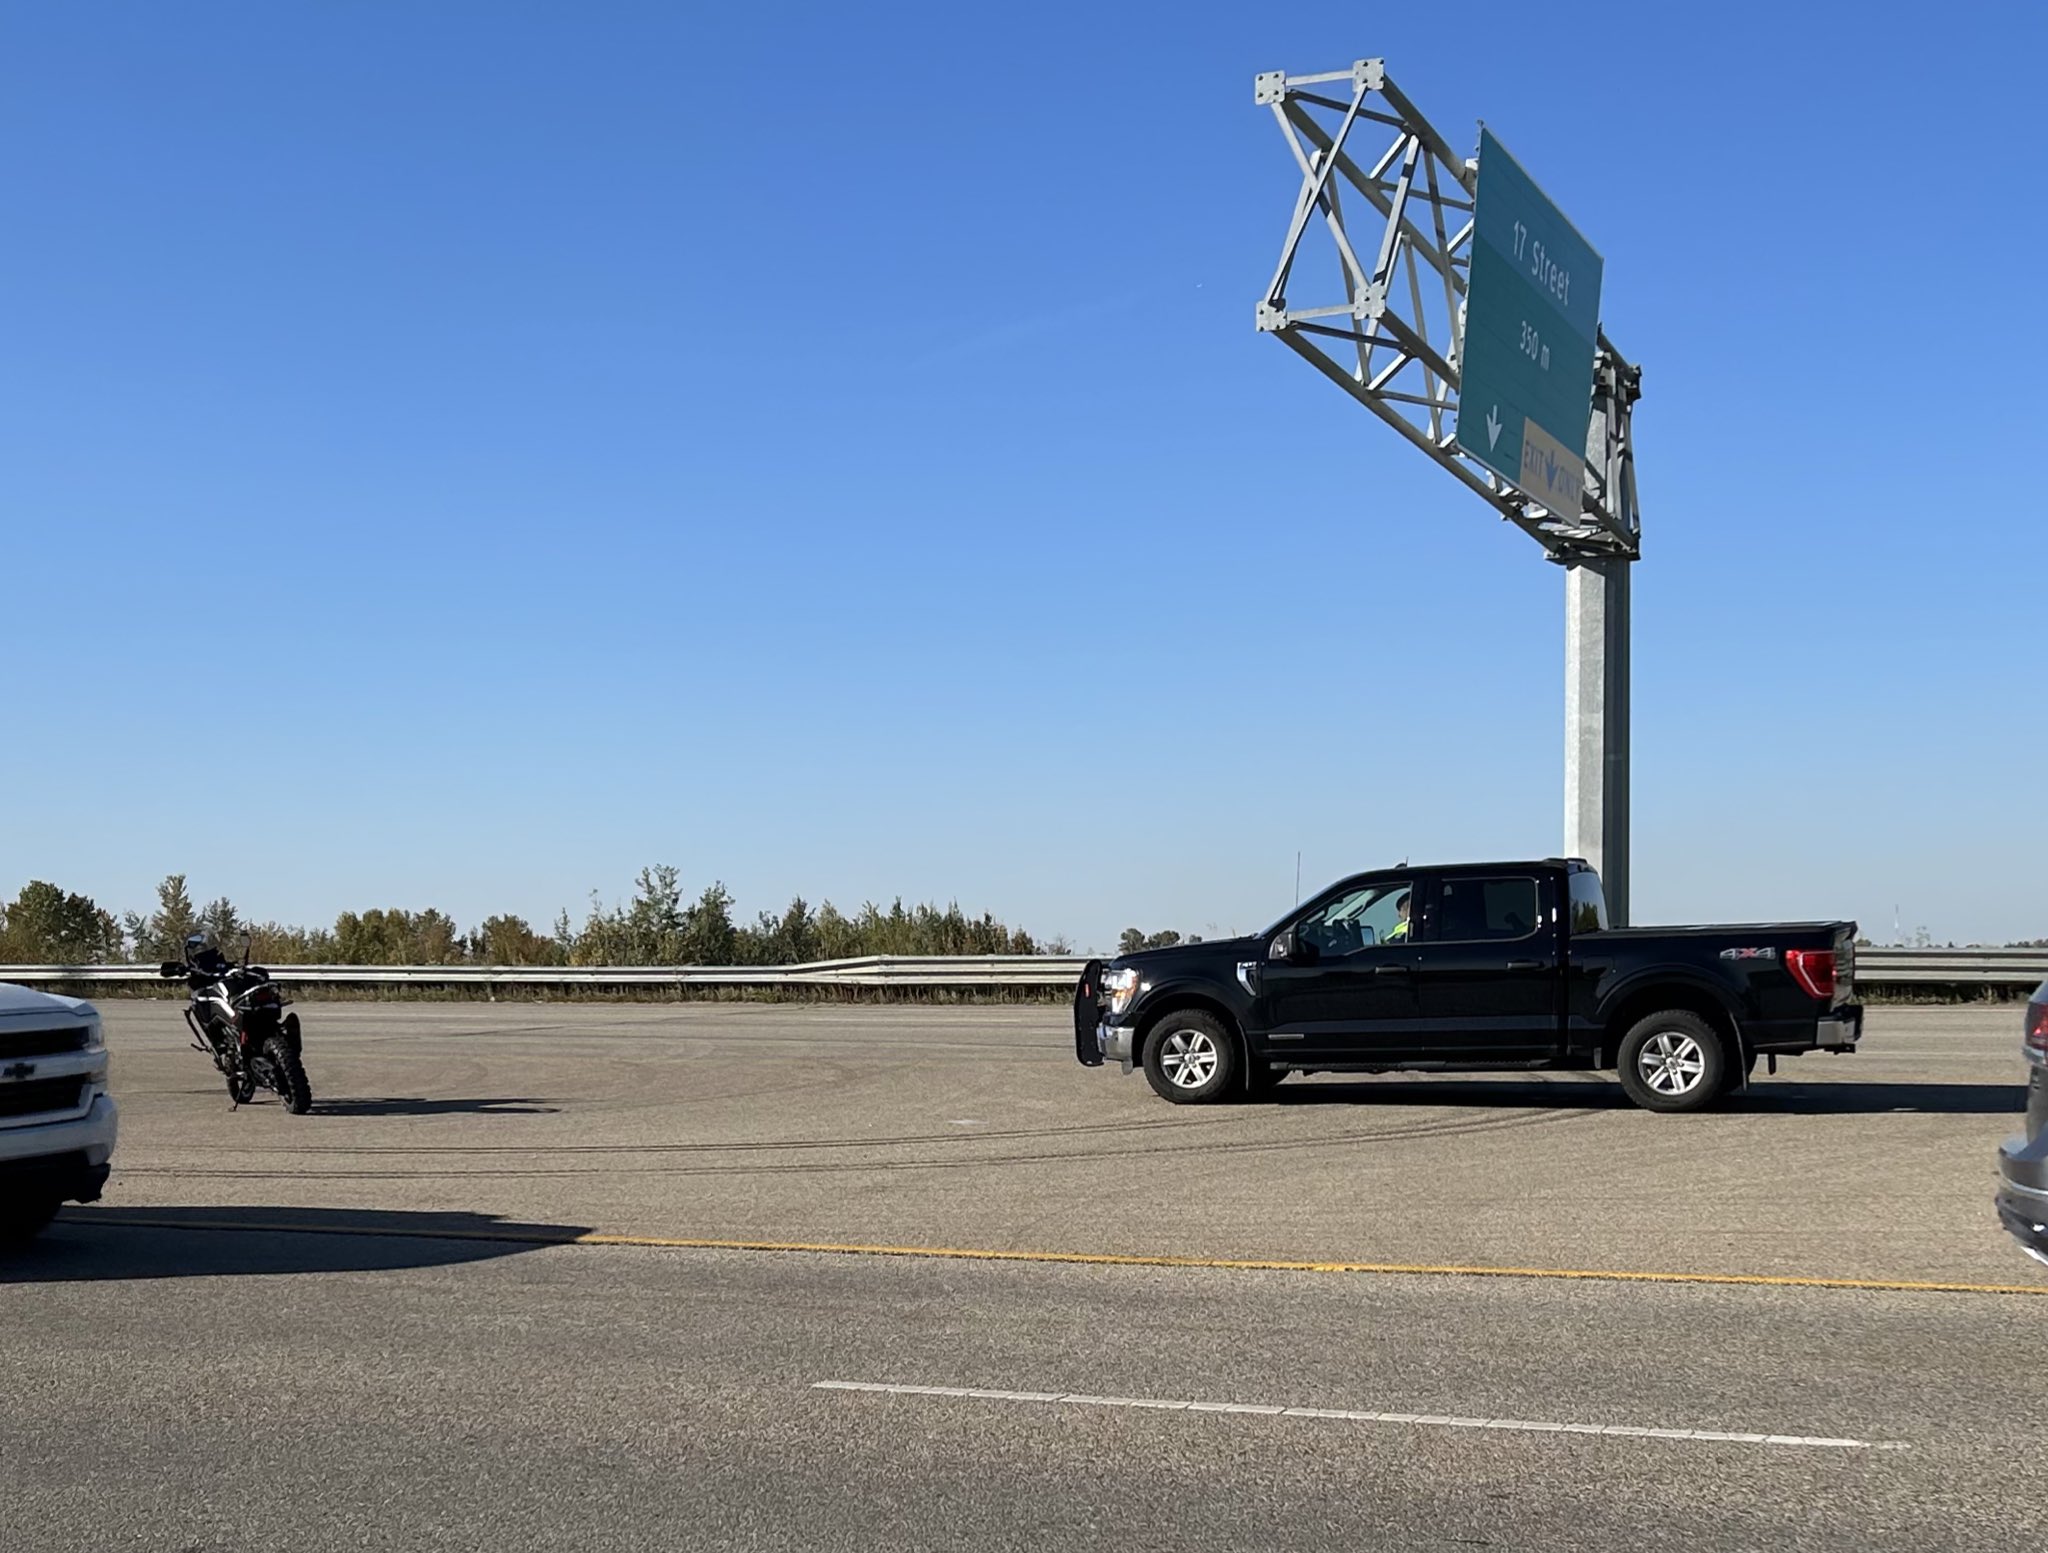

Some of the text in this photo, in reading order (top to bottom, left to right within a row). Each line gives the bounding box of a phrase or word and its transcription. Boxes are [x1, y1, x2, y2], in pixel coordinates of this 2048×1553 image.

[1513, 220, 1570, 306] 17 Street
[1519, 320, 1551, 371] 350 m
